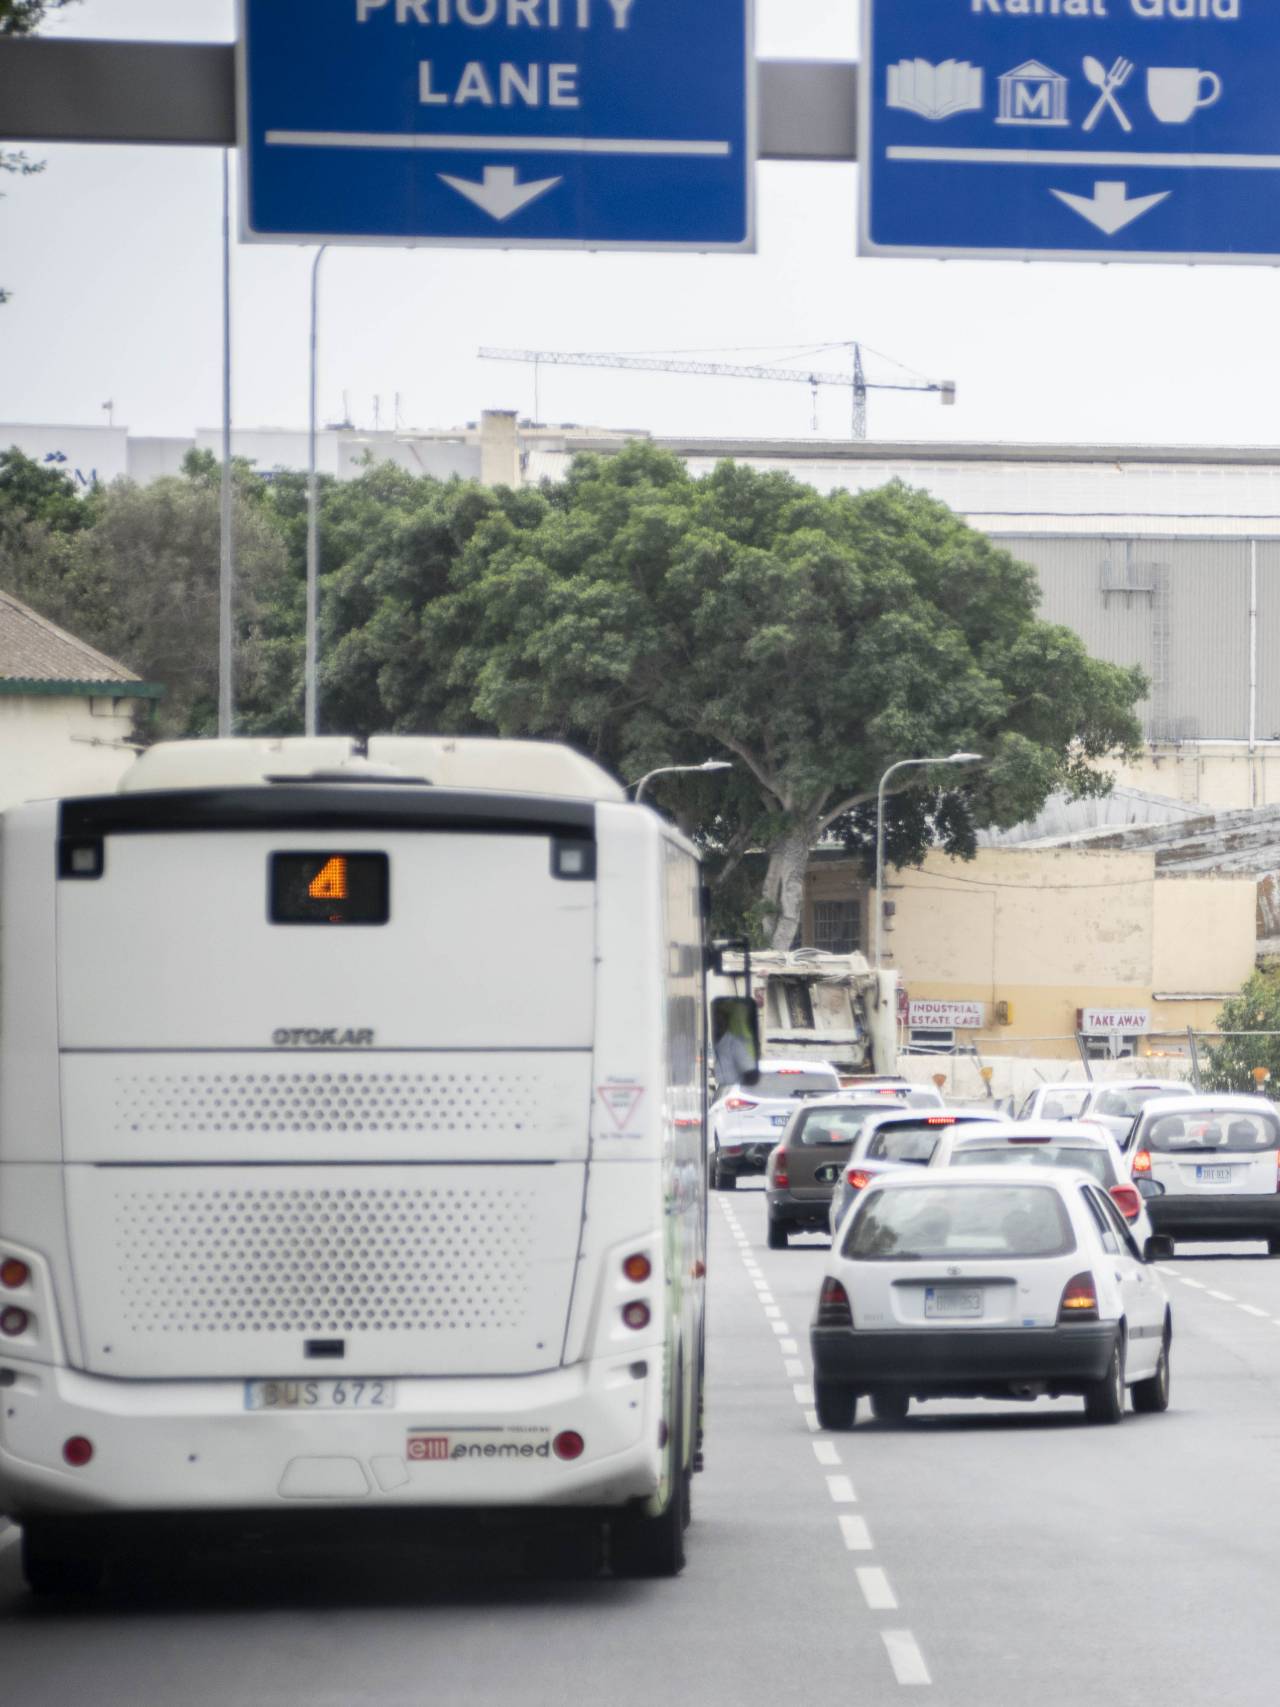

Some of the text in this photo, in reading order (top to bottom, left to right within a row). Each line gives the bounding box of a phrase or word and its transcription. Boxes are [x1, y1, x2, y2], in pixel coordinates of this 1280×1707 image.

[418, 60, 580, 107] LANE
[913, 1003, 980, 1014] INDUSTRIAL
[911, 1015, 951, 1025] ESTATE
[1088, 1014, 1146, 1027] TAKE AWAY
[272, 1028, 374, 1046] OTOKAR
[264, 1380, 384, 1405] BUS 672
[453, 1441, 549, 1458] enemed
